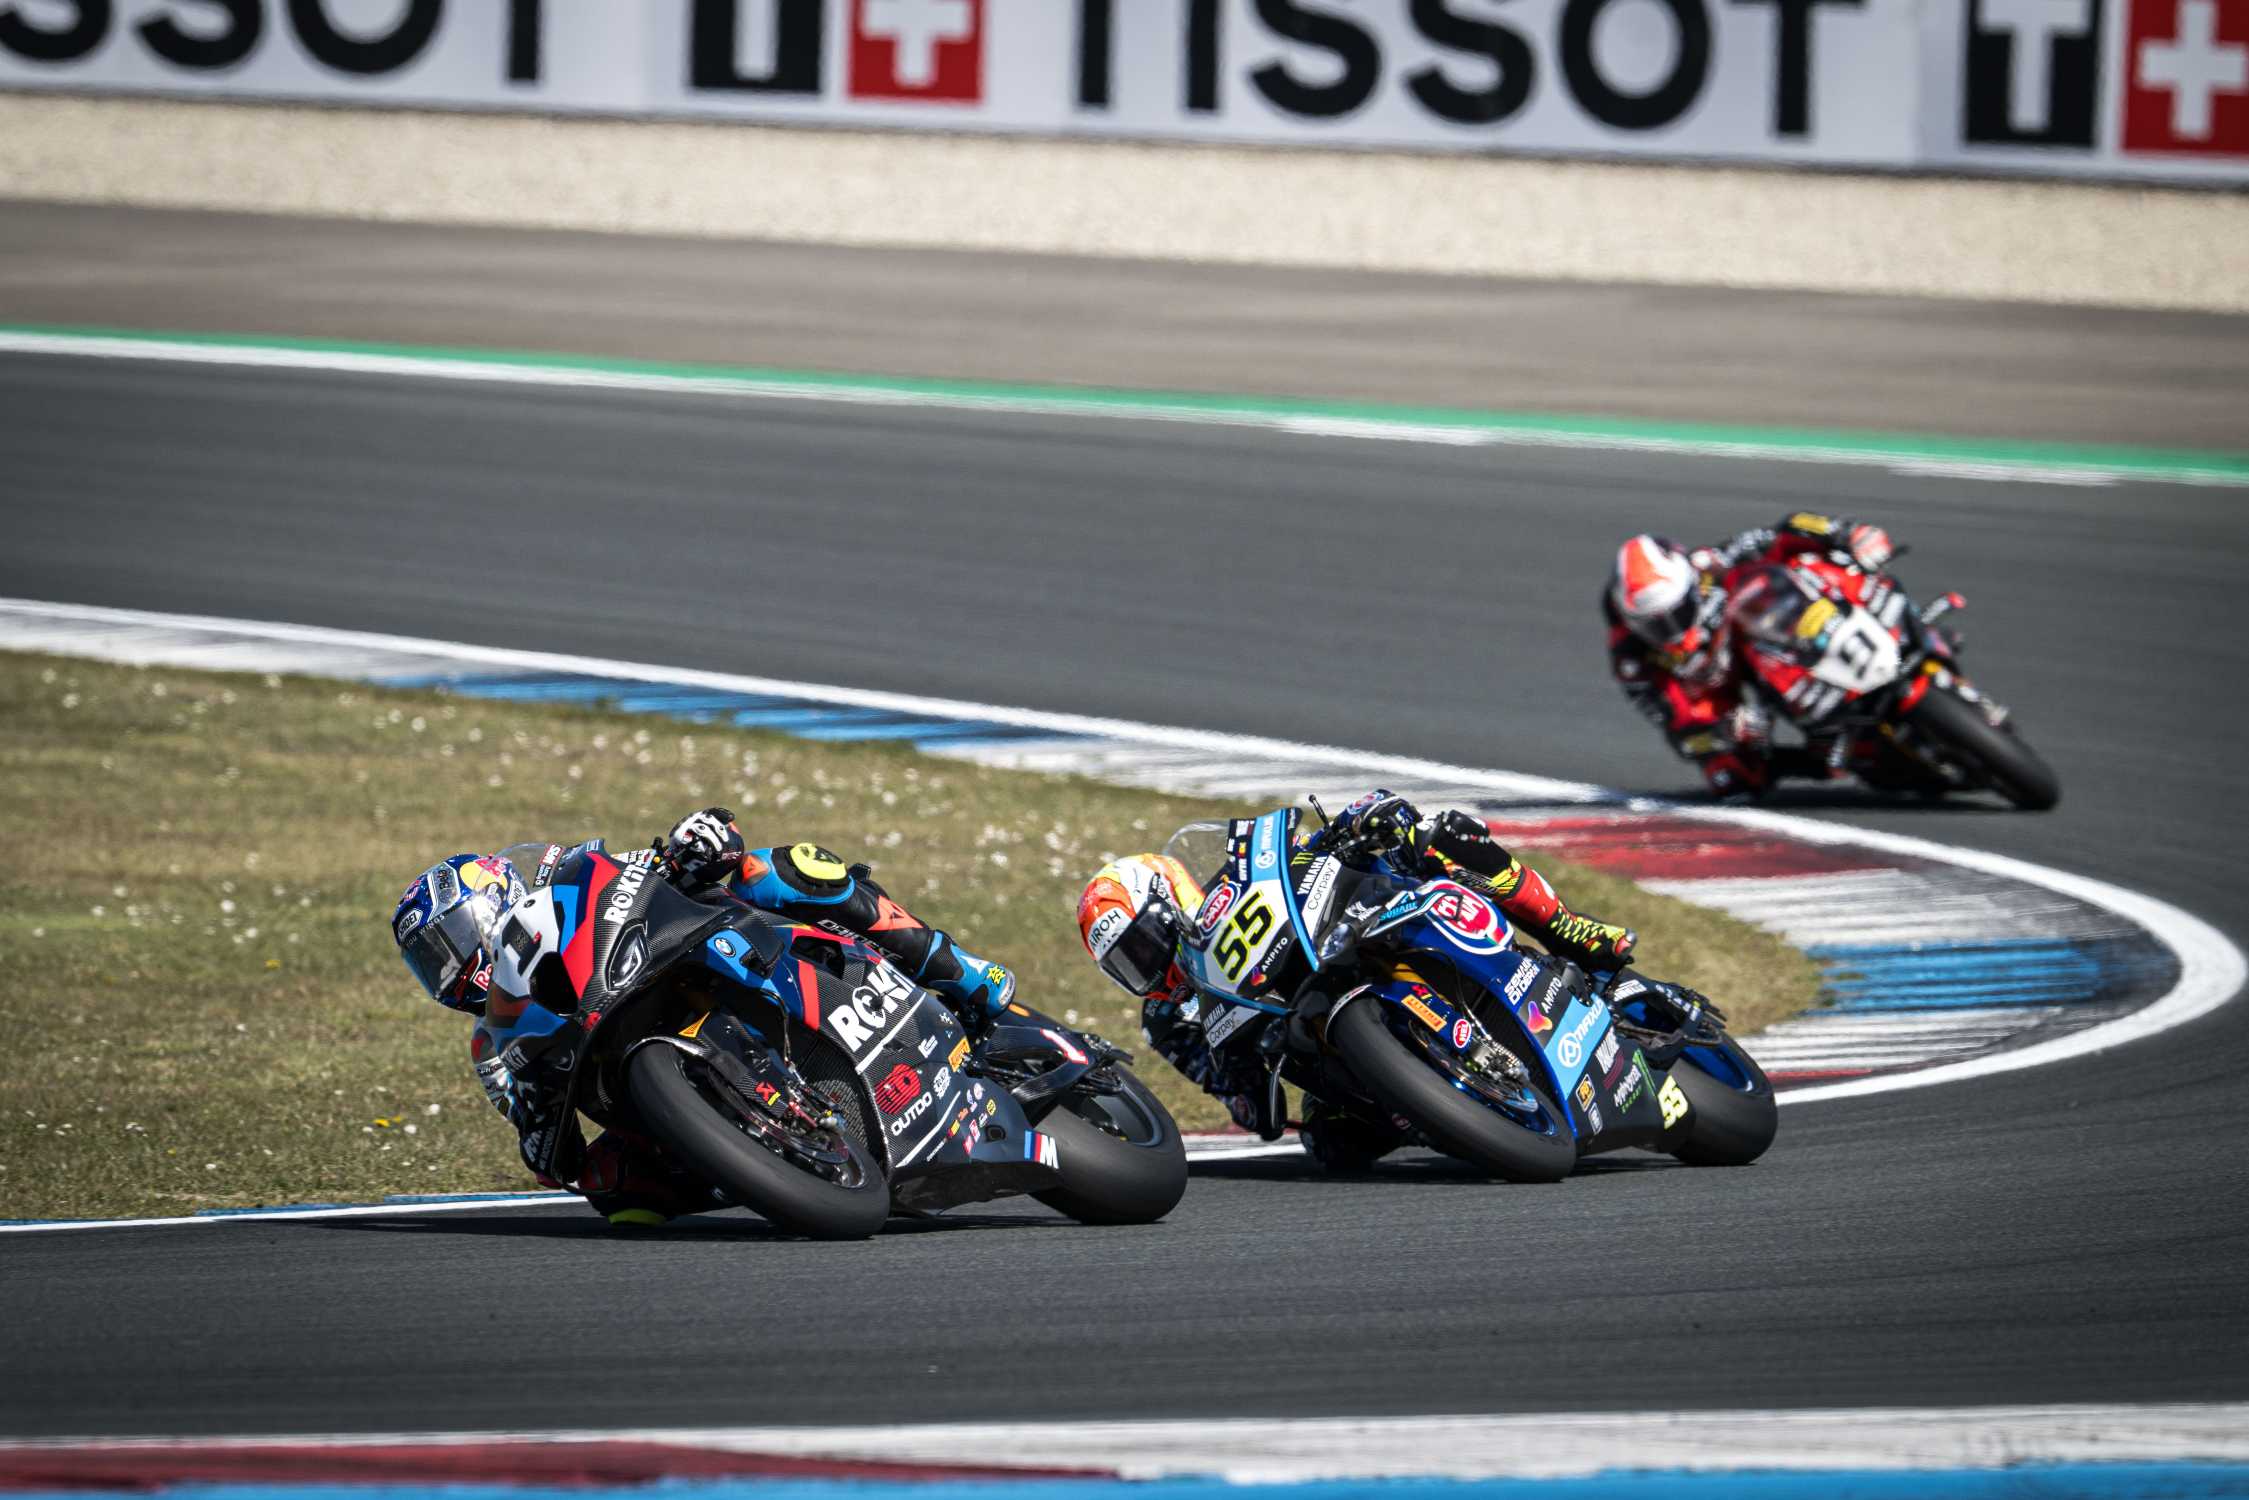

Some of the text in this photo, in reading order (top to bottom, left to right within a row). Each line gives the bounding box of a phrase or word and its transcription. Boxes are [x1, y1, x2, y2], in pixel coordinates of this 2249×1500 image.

[1296, 855, 1329, 895] YAMAHA
[1213, 889, 1277, 983] 55
[1261, 936, 1289, 972] AMPITO
[1541, 976, 1563, 1014] AMPITO
[890, 1091, 933, 1136] OUTDO
